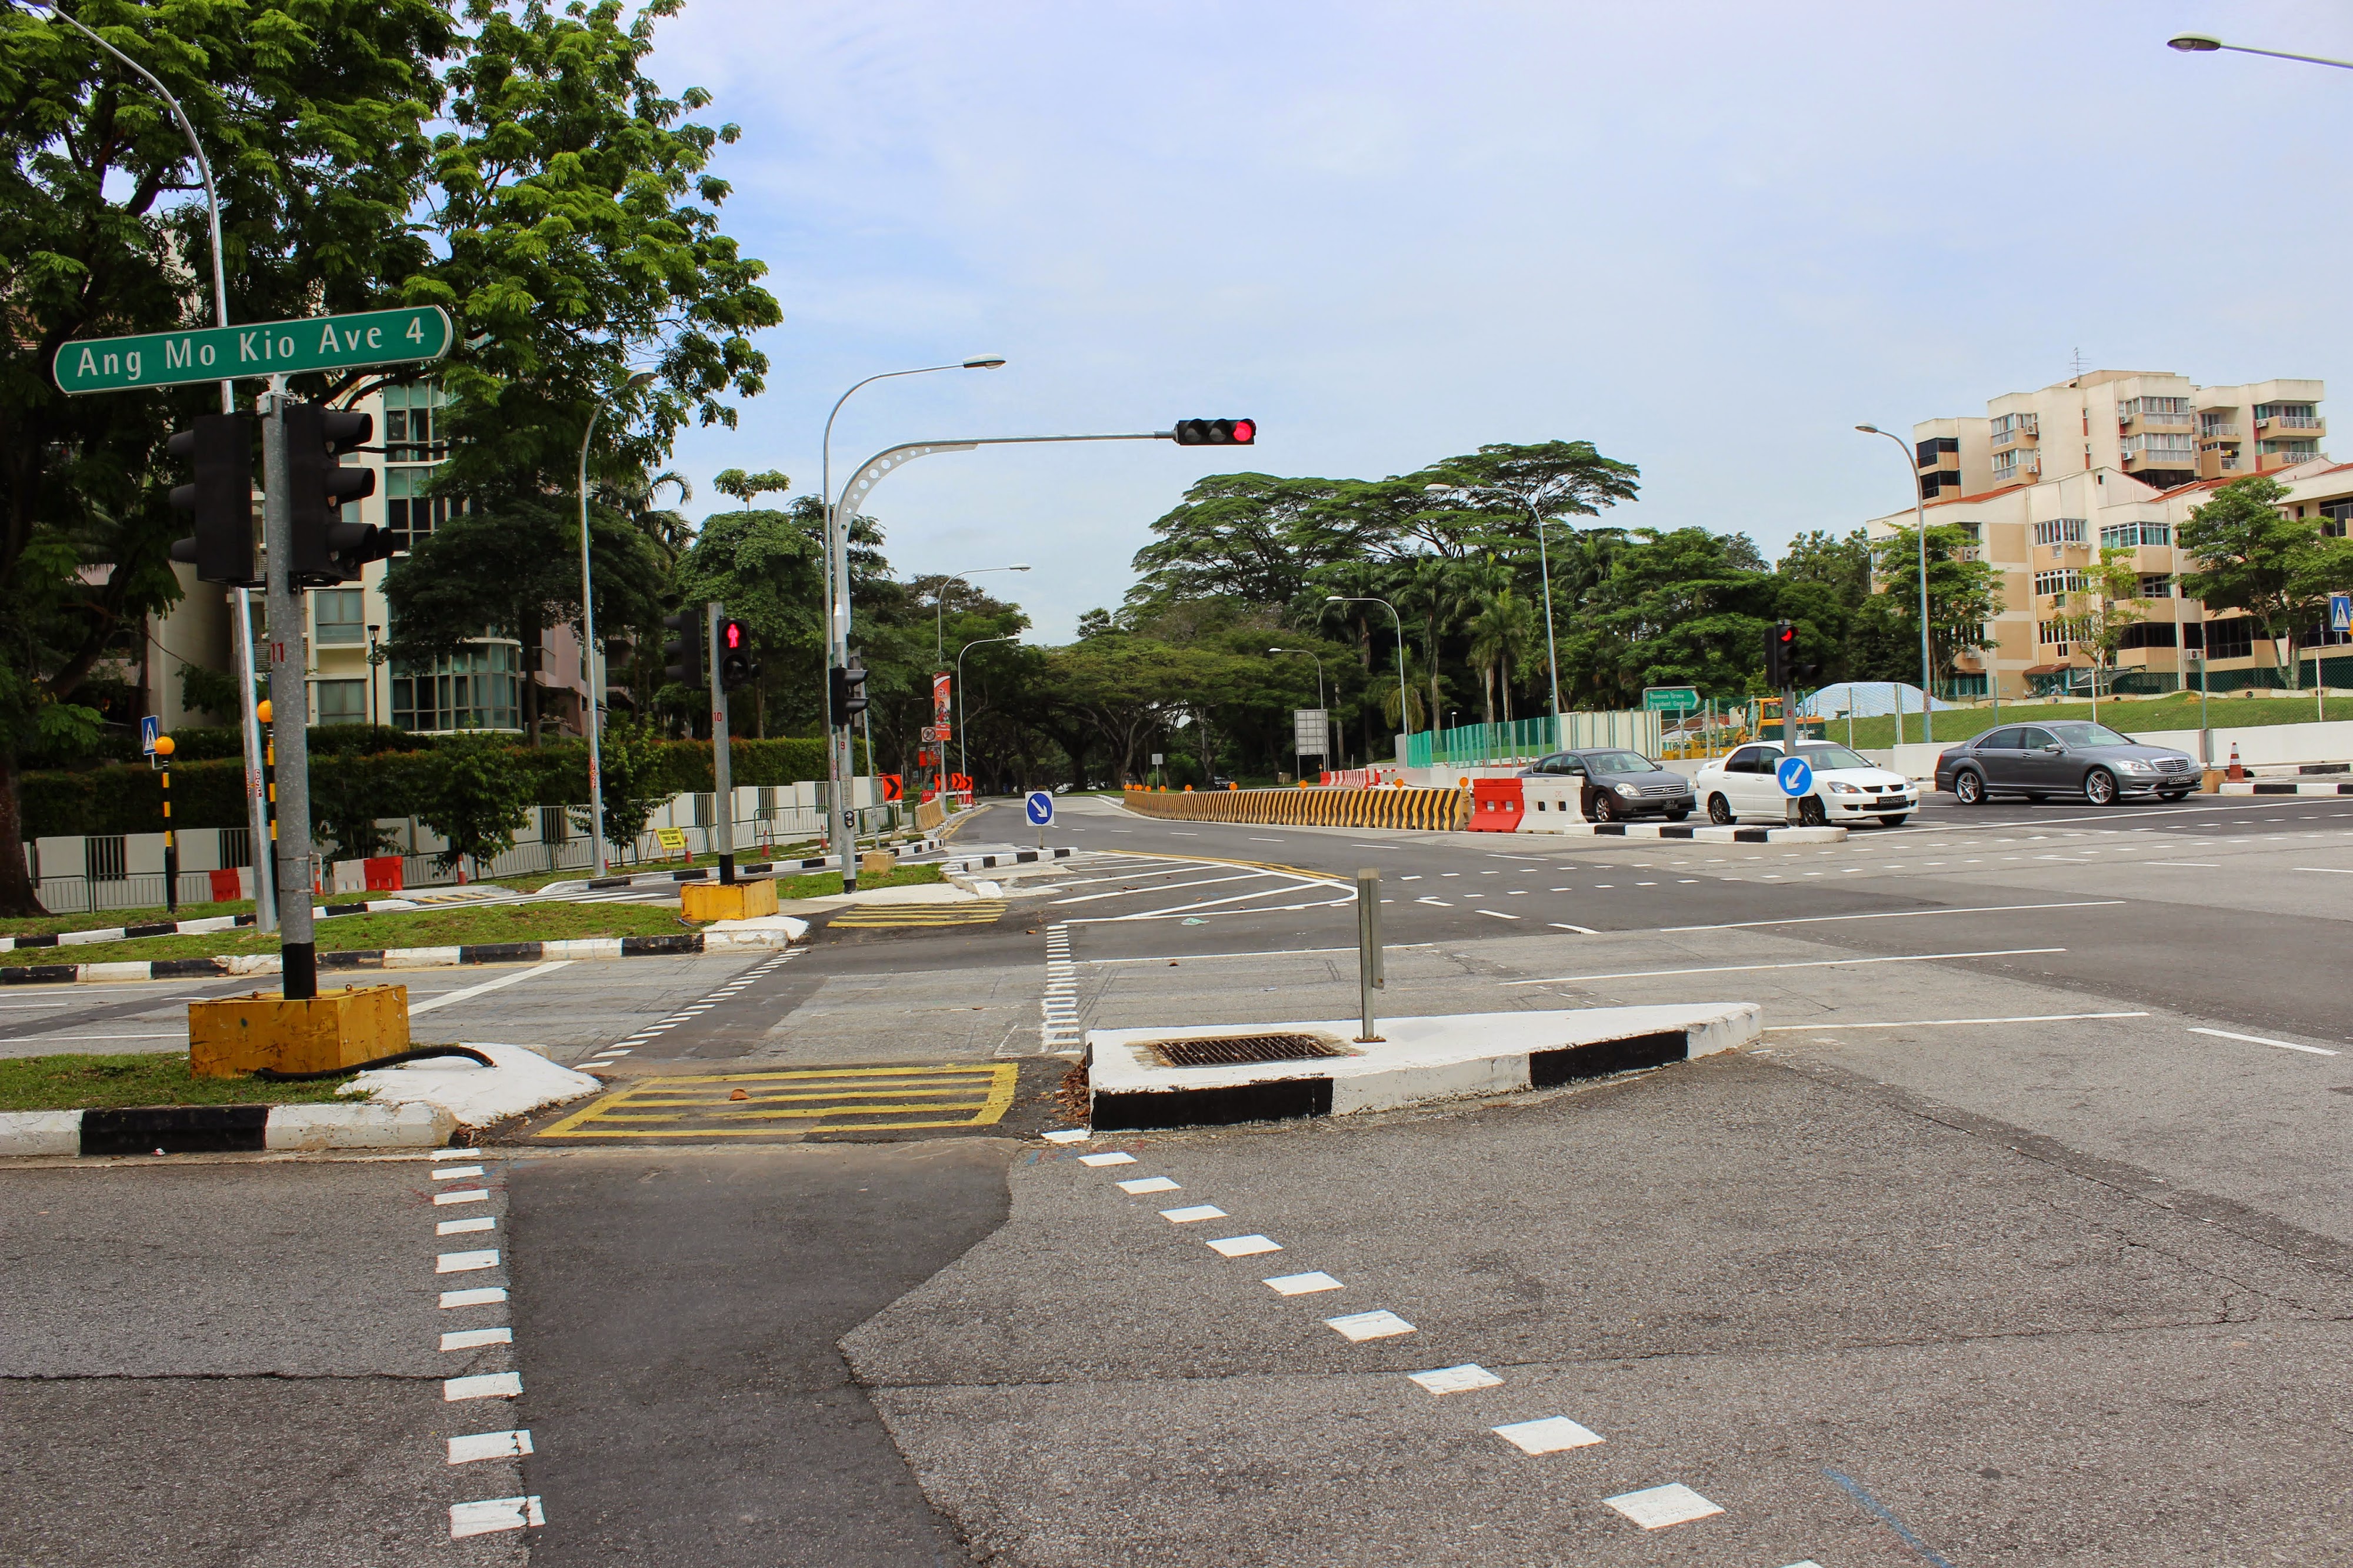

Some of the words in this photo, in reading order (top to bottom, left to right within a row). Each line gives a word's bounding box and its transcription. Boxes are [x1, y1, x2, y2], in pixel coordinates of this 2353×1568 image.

[76, 347, 142, 381] Ang
[165, 338, 216, 369] Mo
[239, 331, 295, 362] Kio
[318, 323, 382, 355] Ave
[405, 316, 425, 345] 4
[271, 642, 284, 663] 11
[714, 712, 722, 722] 10
[840, 741, 845, 750] 9
